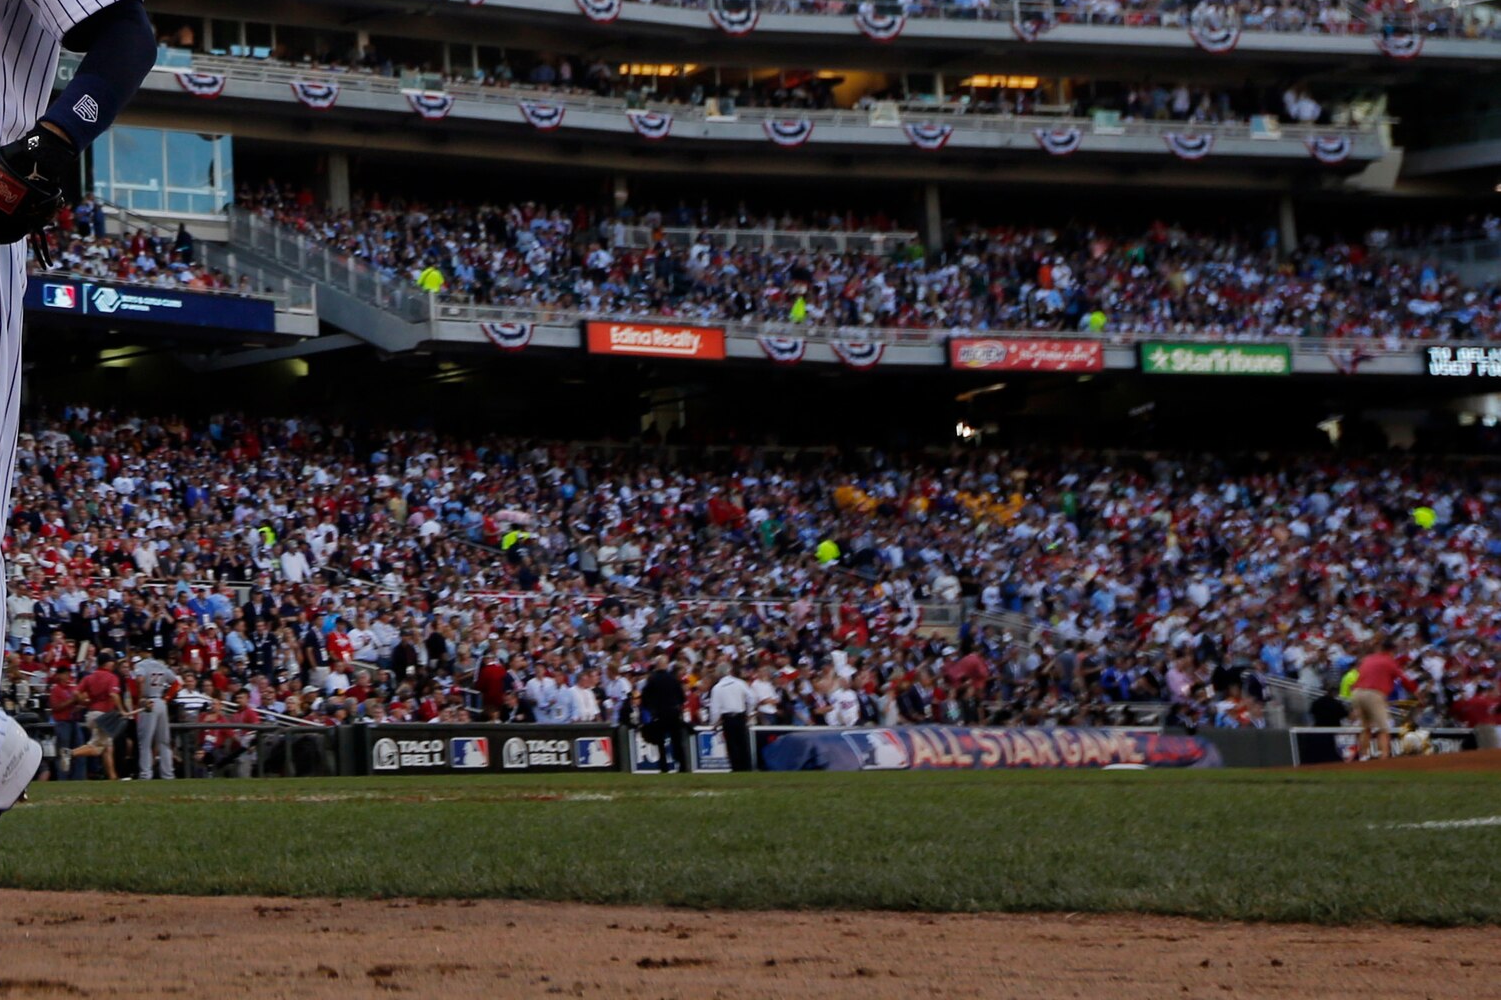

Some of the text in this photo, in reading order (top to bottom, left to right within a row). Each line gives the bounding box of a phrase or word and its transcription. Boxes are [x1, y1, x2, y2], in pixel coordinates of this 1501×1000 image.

[610, 326, 702, 350] Edina Realty
[1170, 347, 1286, 373] StarTribune
[1429, 361, 1473, 376] USED
[397, 740, 444, 752] TACO
[526, 740, 570, 752] TACO
[912, 728, 974, 765] ALL
[970, 728, 1060, 765] STAR
[401, 752, 447, 766] BELL
[529, 752, 573, 766] BELL
